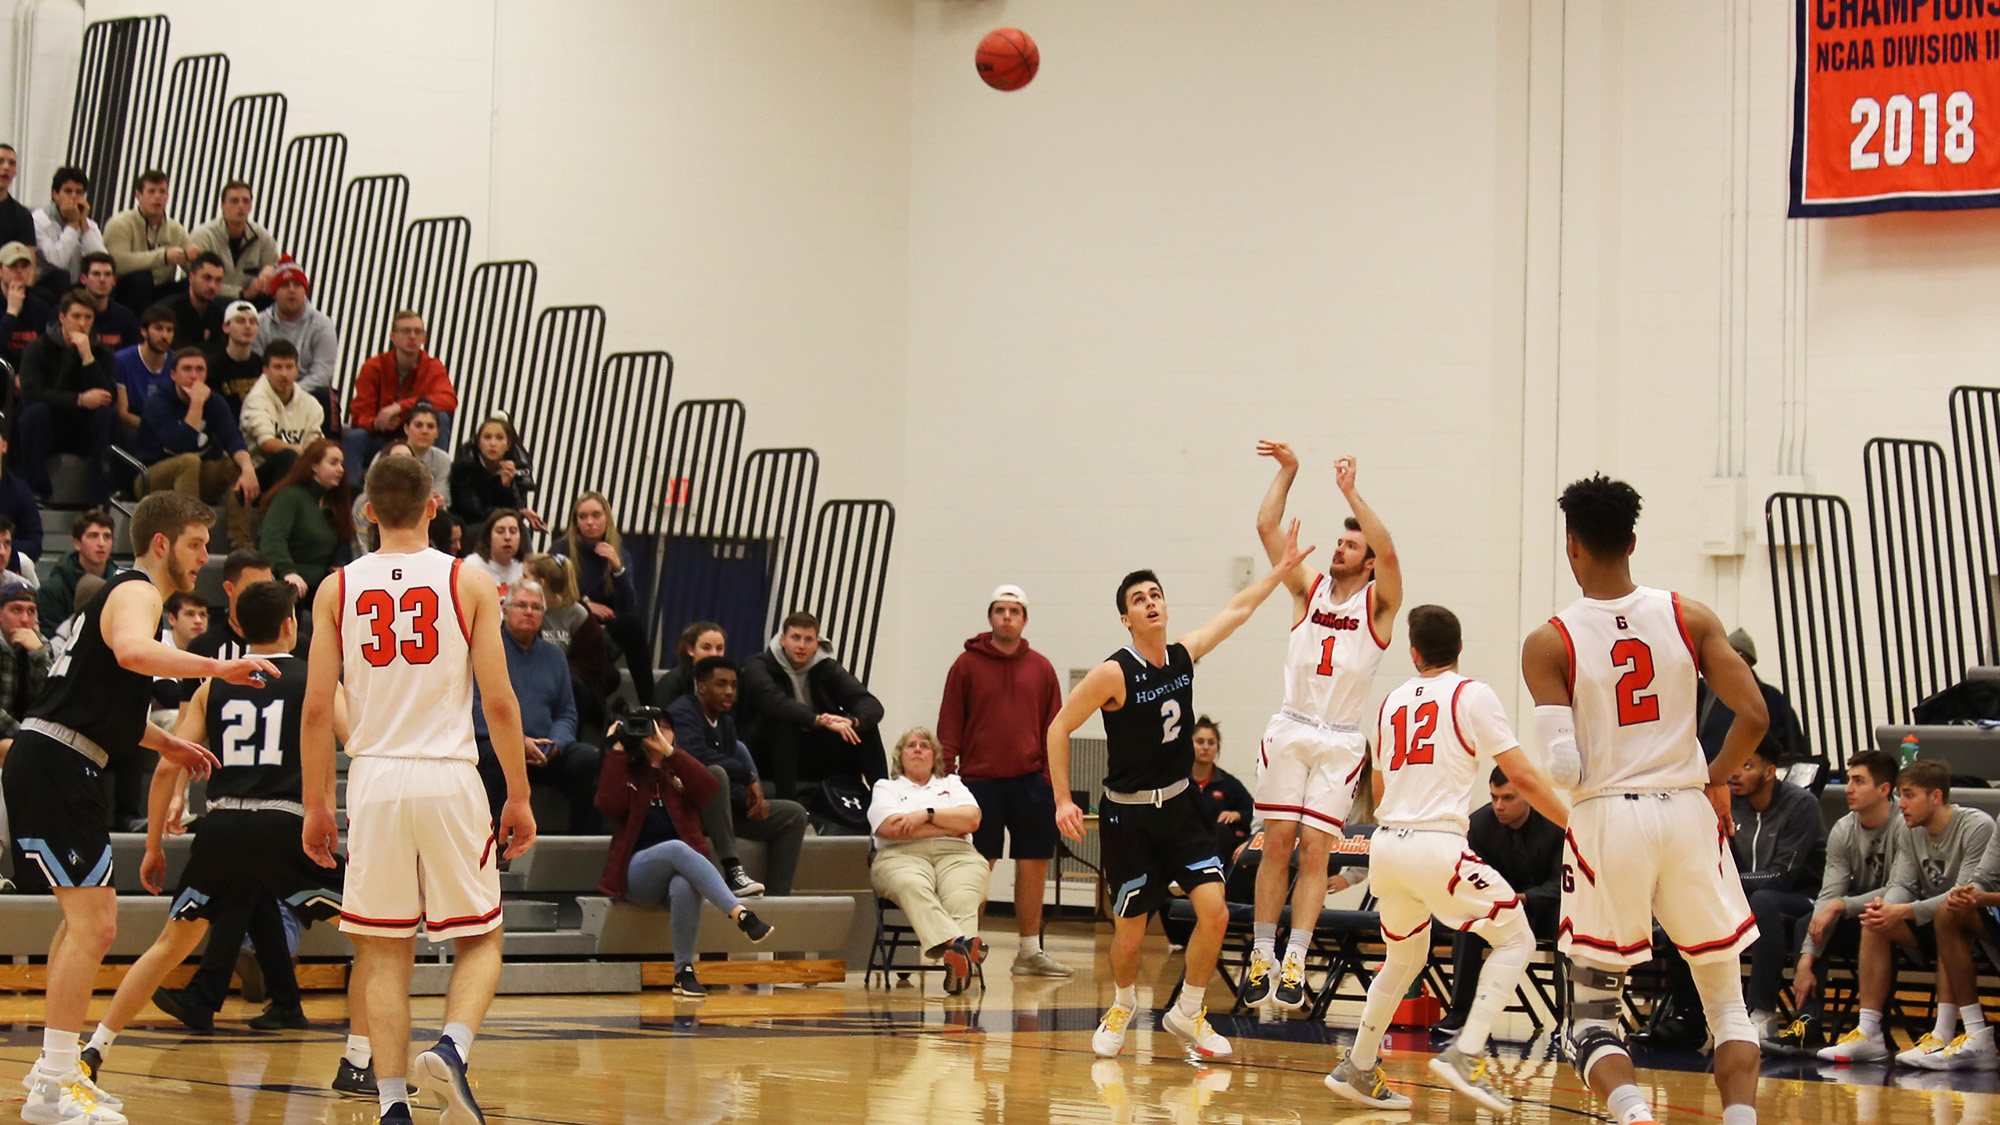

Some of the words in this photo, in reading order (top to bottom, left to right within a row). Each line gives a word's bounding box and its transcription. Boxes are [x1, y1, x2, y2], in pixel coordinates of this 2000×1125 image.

[1816, 39, 1875, 73] NCAA
[1883, 31, 1978, 68] DIVISION
[1850, 90, 1975, 171] 2018
[391, 568, 403, 581] G
[355, 586, 439, 667] 33
[1615, 615, 1629, 630] G
[1316, 635, 1336, 677] 1
[1610, 637, 1660, 727] 2
[221, 699, 285, 767] 21
[1160, 698, 1182, 744] 2
[1389, 700, 1439, 771] 12
[1561, 863, 1575, 894] G
